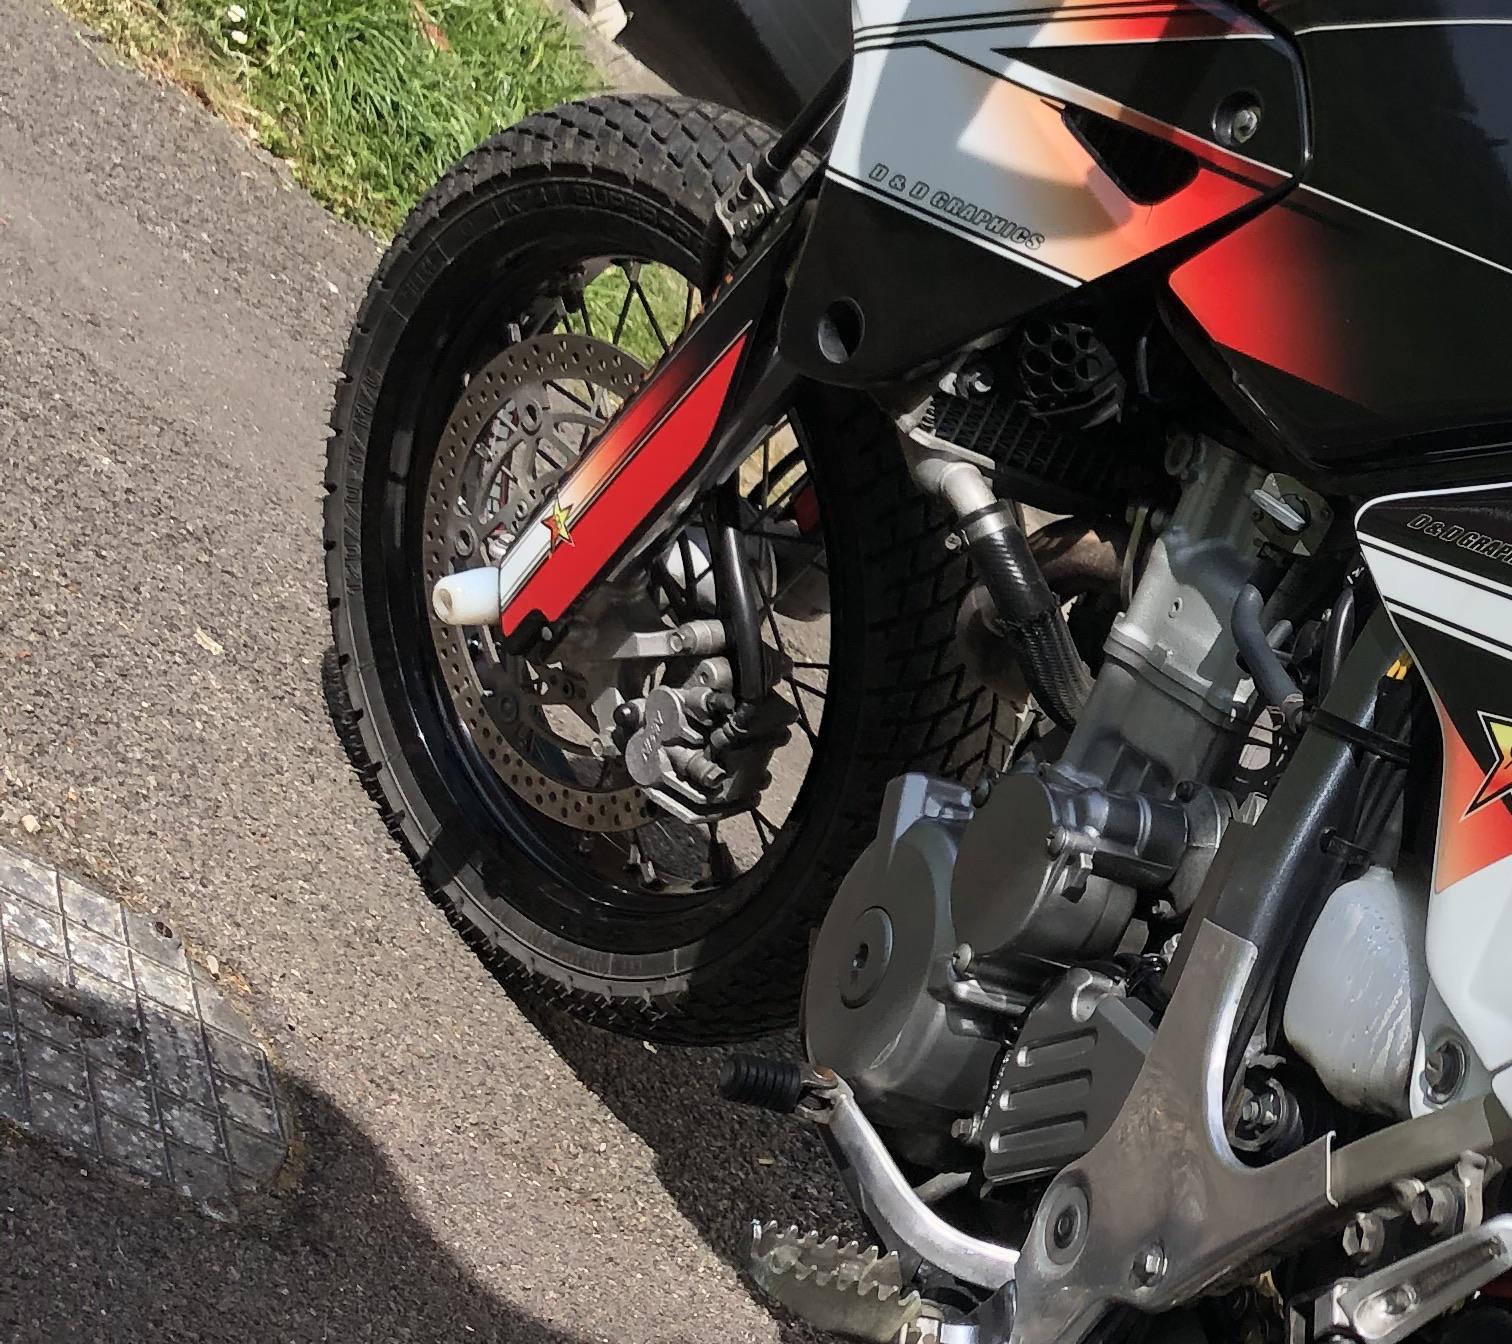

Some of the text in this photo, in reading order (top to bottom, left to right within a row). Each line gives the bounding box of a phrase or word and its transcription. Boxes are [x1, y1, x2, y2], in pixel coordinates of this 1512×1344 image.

[868, 162, 890, 183] D
[908, 181, 931, 201] D
[930, 191, 1046, 250] GRAPHICS
[1407, 513, 1433, 530] D
[1439, 525, 1465, 542] D
